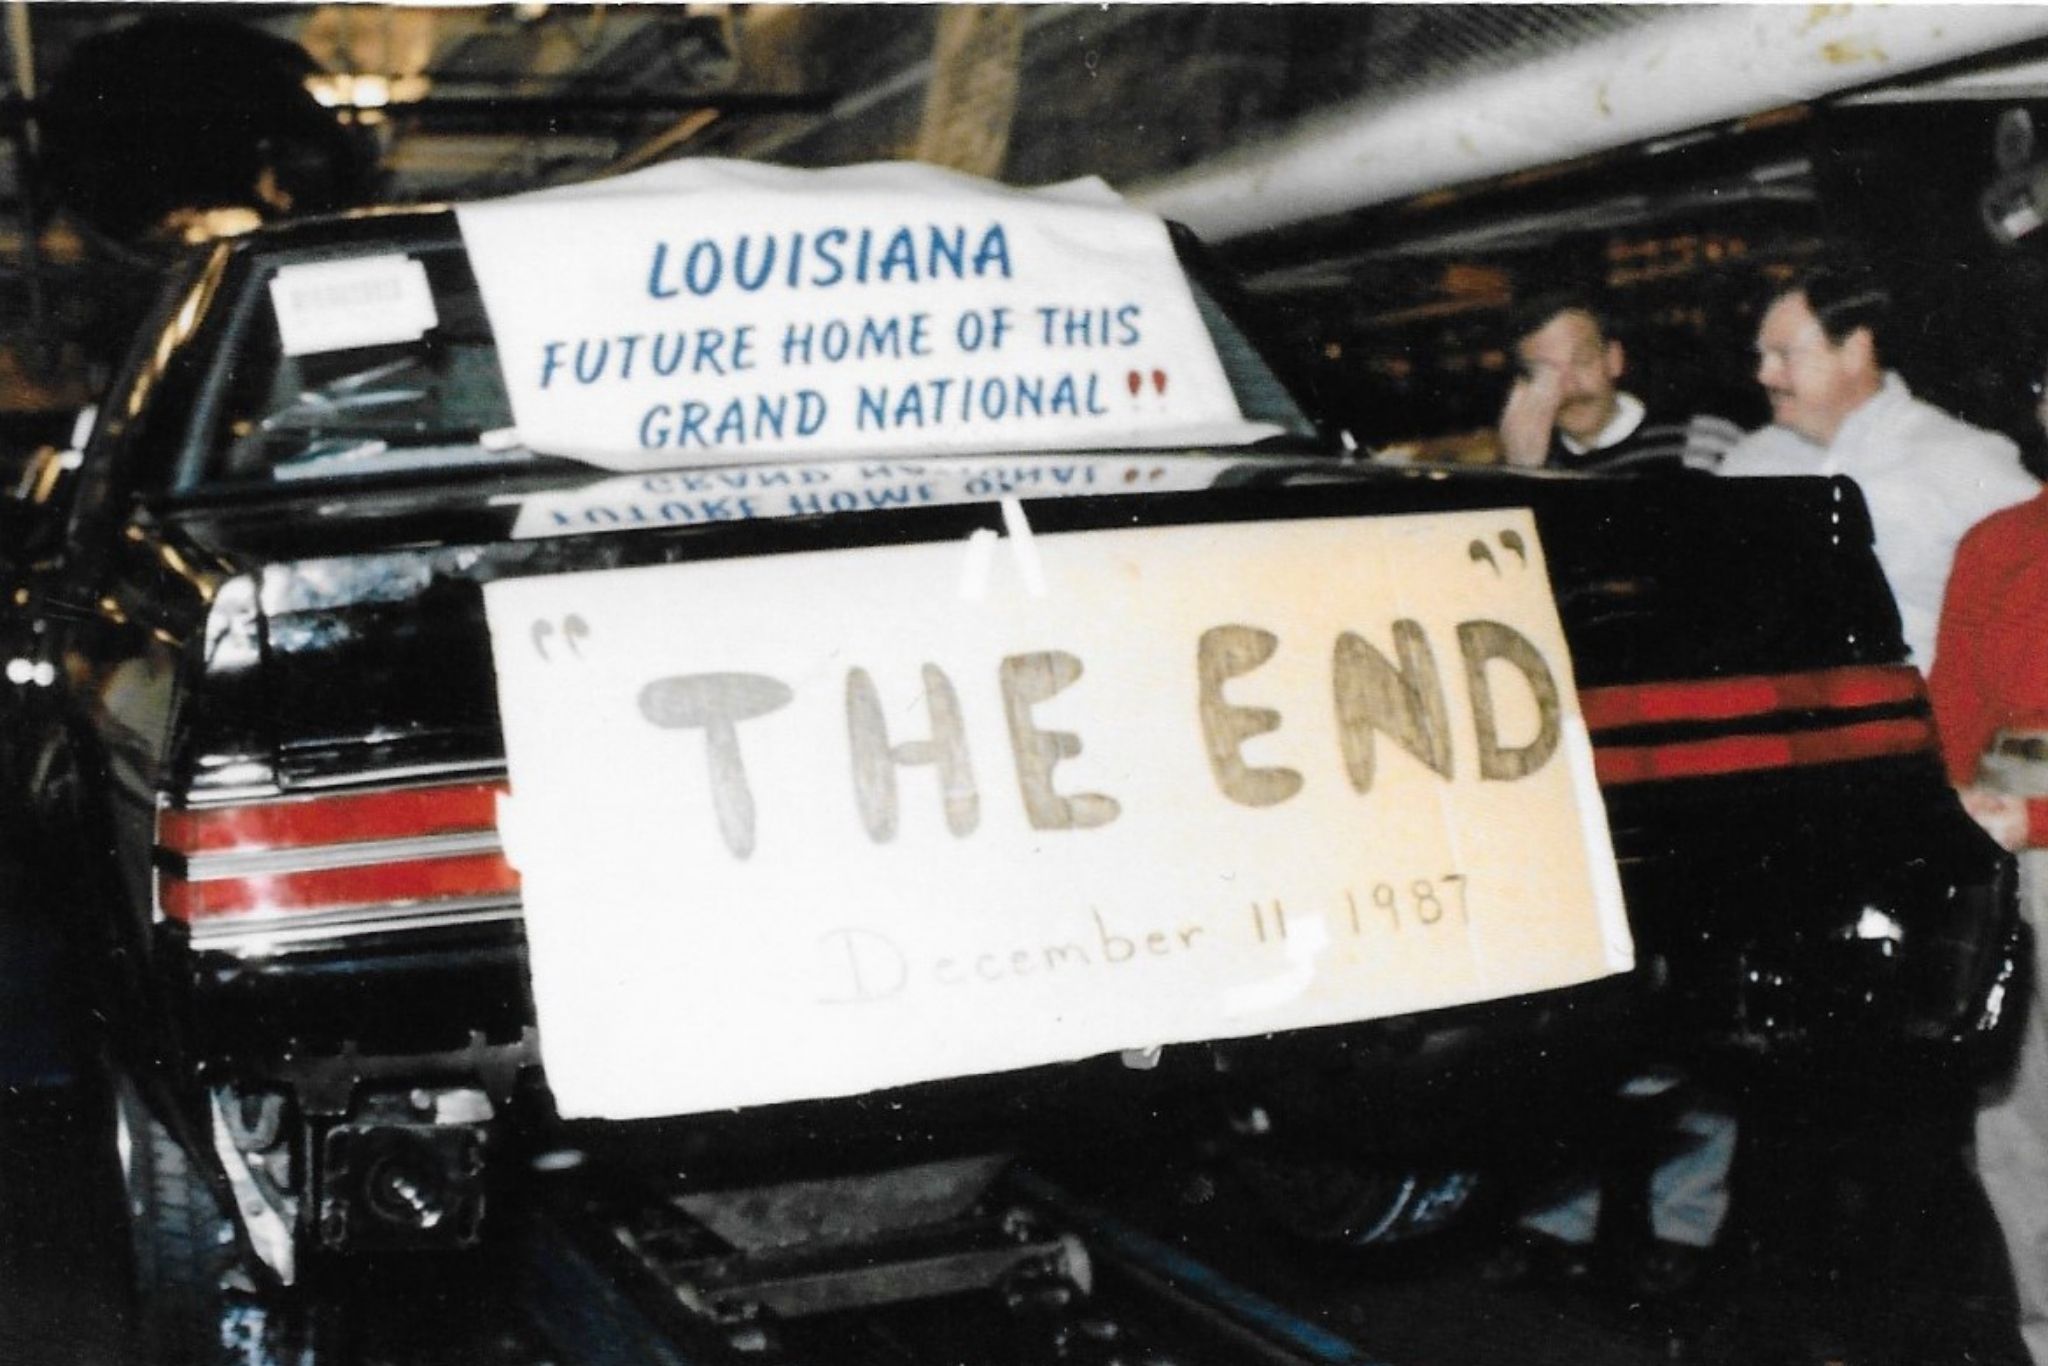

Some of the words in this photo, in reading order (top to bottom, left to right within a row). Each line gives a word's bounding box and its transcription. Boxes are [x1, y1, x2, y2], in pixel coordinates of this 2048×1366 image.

[648, 222, 1013, 299] LOUISIANA
[540, 325, 756, 389] FUTURE
[781, 312, 932, 366] HOME
[956, 306, 1013, 352] OF
[1036, 303, 1141, 347] THIS
[639, 390, 827, 450] GRAND
[816, 904, 1204, 1005] December
[1345, 873, 1469, 935] 1987
